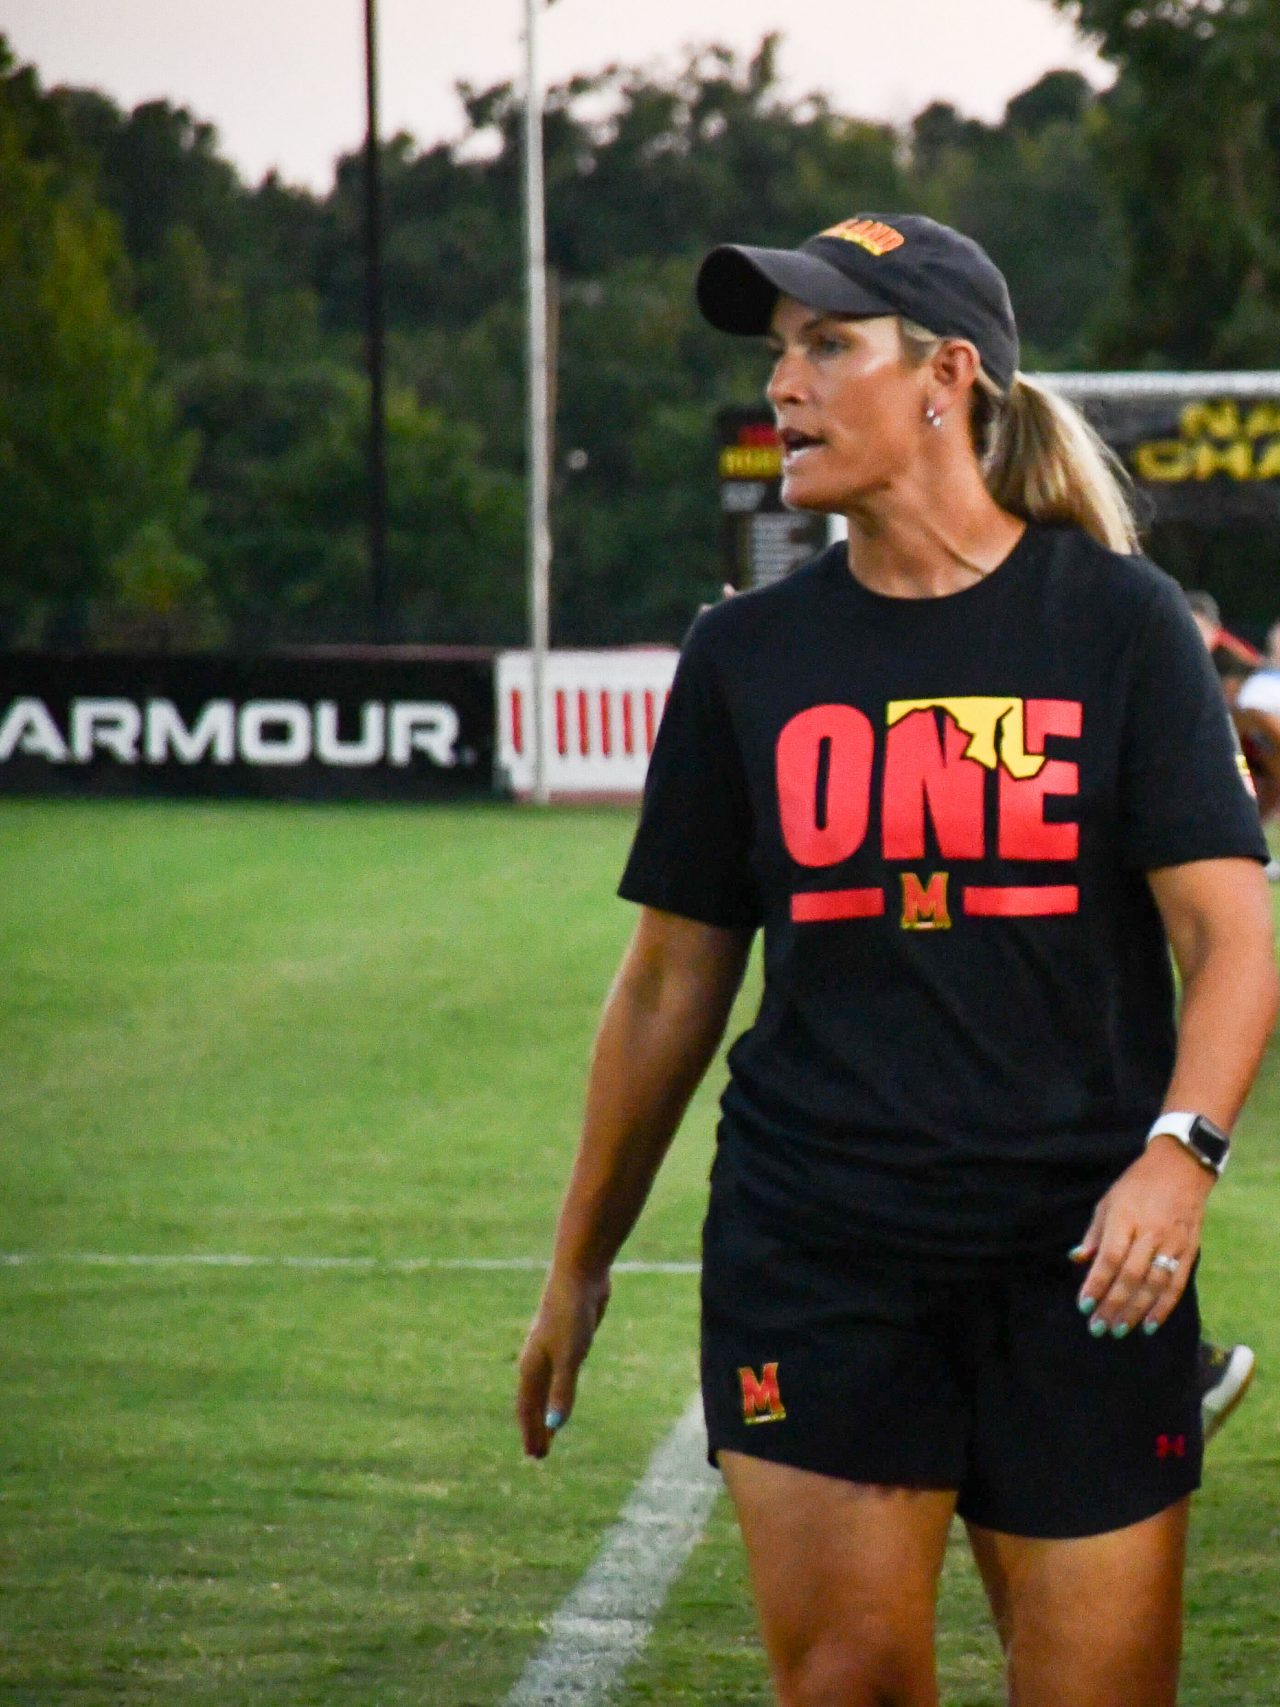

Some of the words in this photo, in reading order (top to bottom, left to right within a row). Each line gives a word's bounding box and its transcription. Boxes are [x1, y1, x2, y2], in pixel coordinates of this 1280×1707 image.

[0, 697, 458, 766] ARMOUR
[776, 697, 1082, 867] ONE
[900, 871, 951, 929] M
[738, 1362, 786, 1426] M
